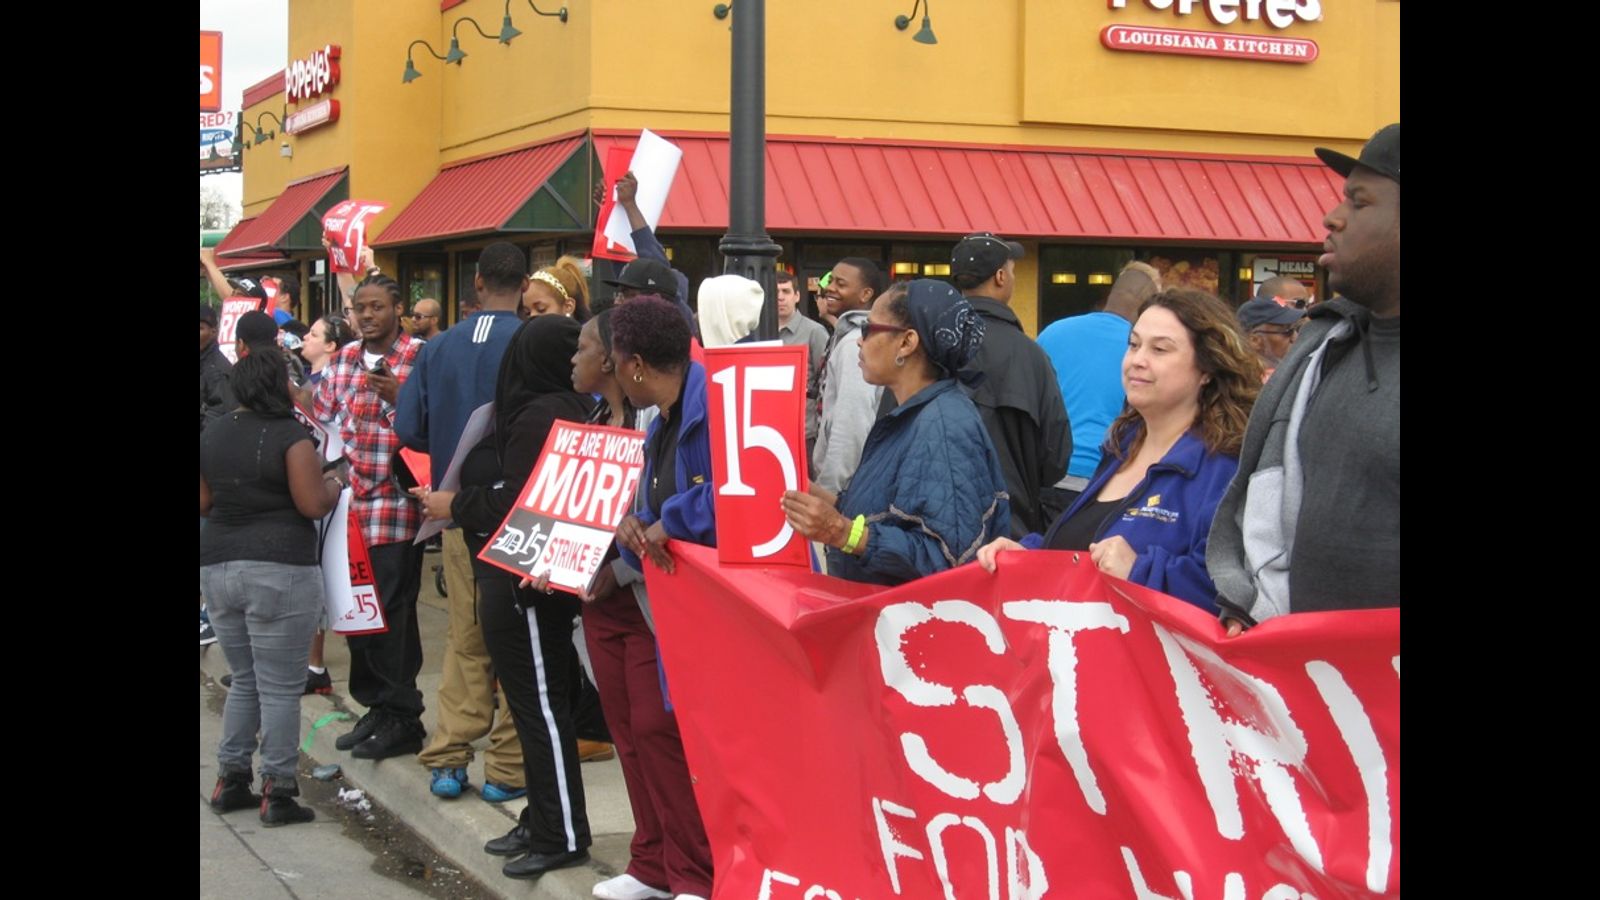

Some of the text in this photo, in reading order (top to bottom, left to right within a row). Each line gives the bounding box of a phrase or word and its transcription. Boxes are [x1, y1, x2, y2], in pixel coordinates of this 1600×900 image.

[1119, 30, 1308, 57] LOUISIANA KITCHEN
[1279, 261, 1315, 273] MEALS
[552, 427, 646, 465] WE ARE WORT
[712, 365, 798, 558] 15
[525, 453, 641, 527] MORE
[543, 537, 591, 573] STRIKE
[353, 593, 378, 621] 15
[875, 599, 1400, 894] STRI
